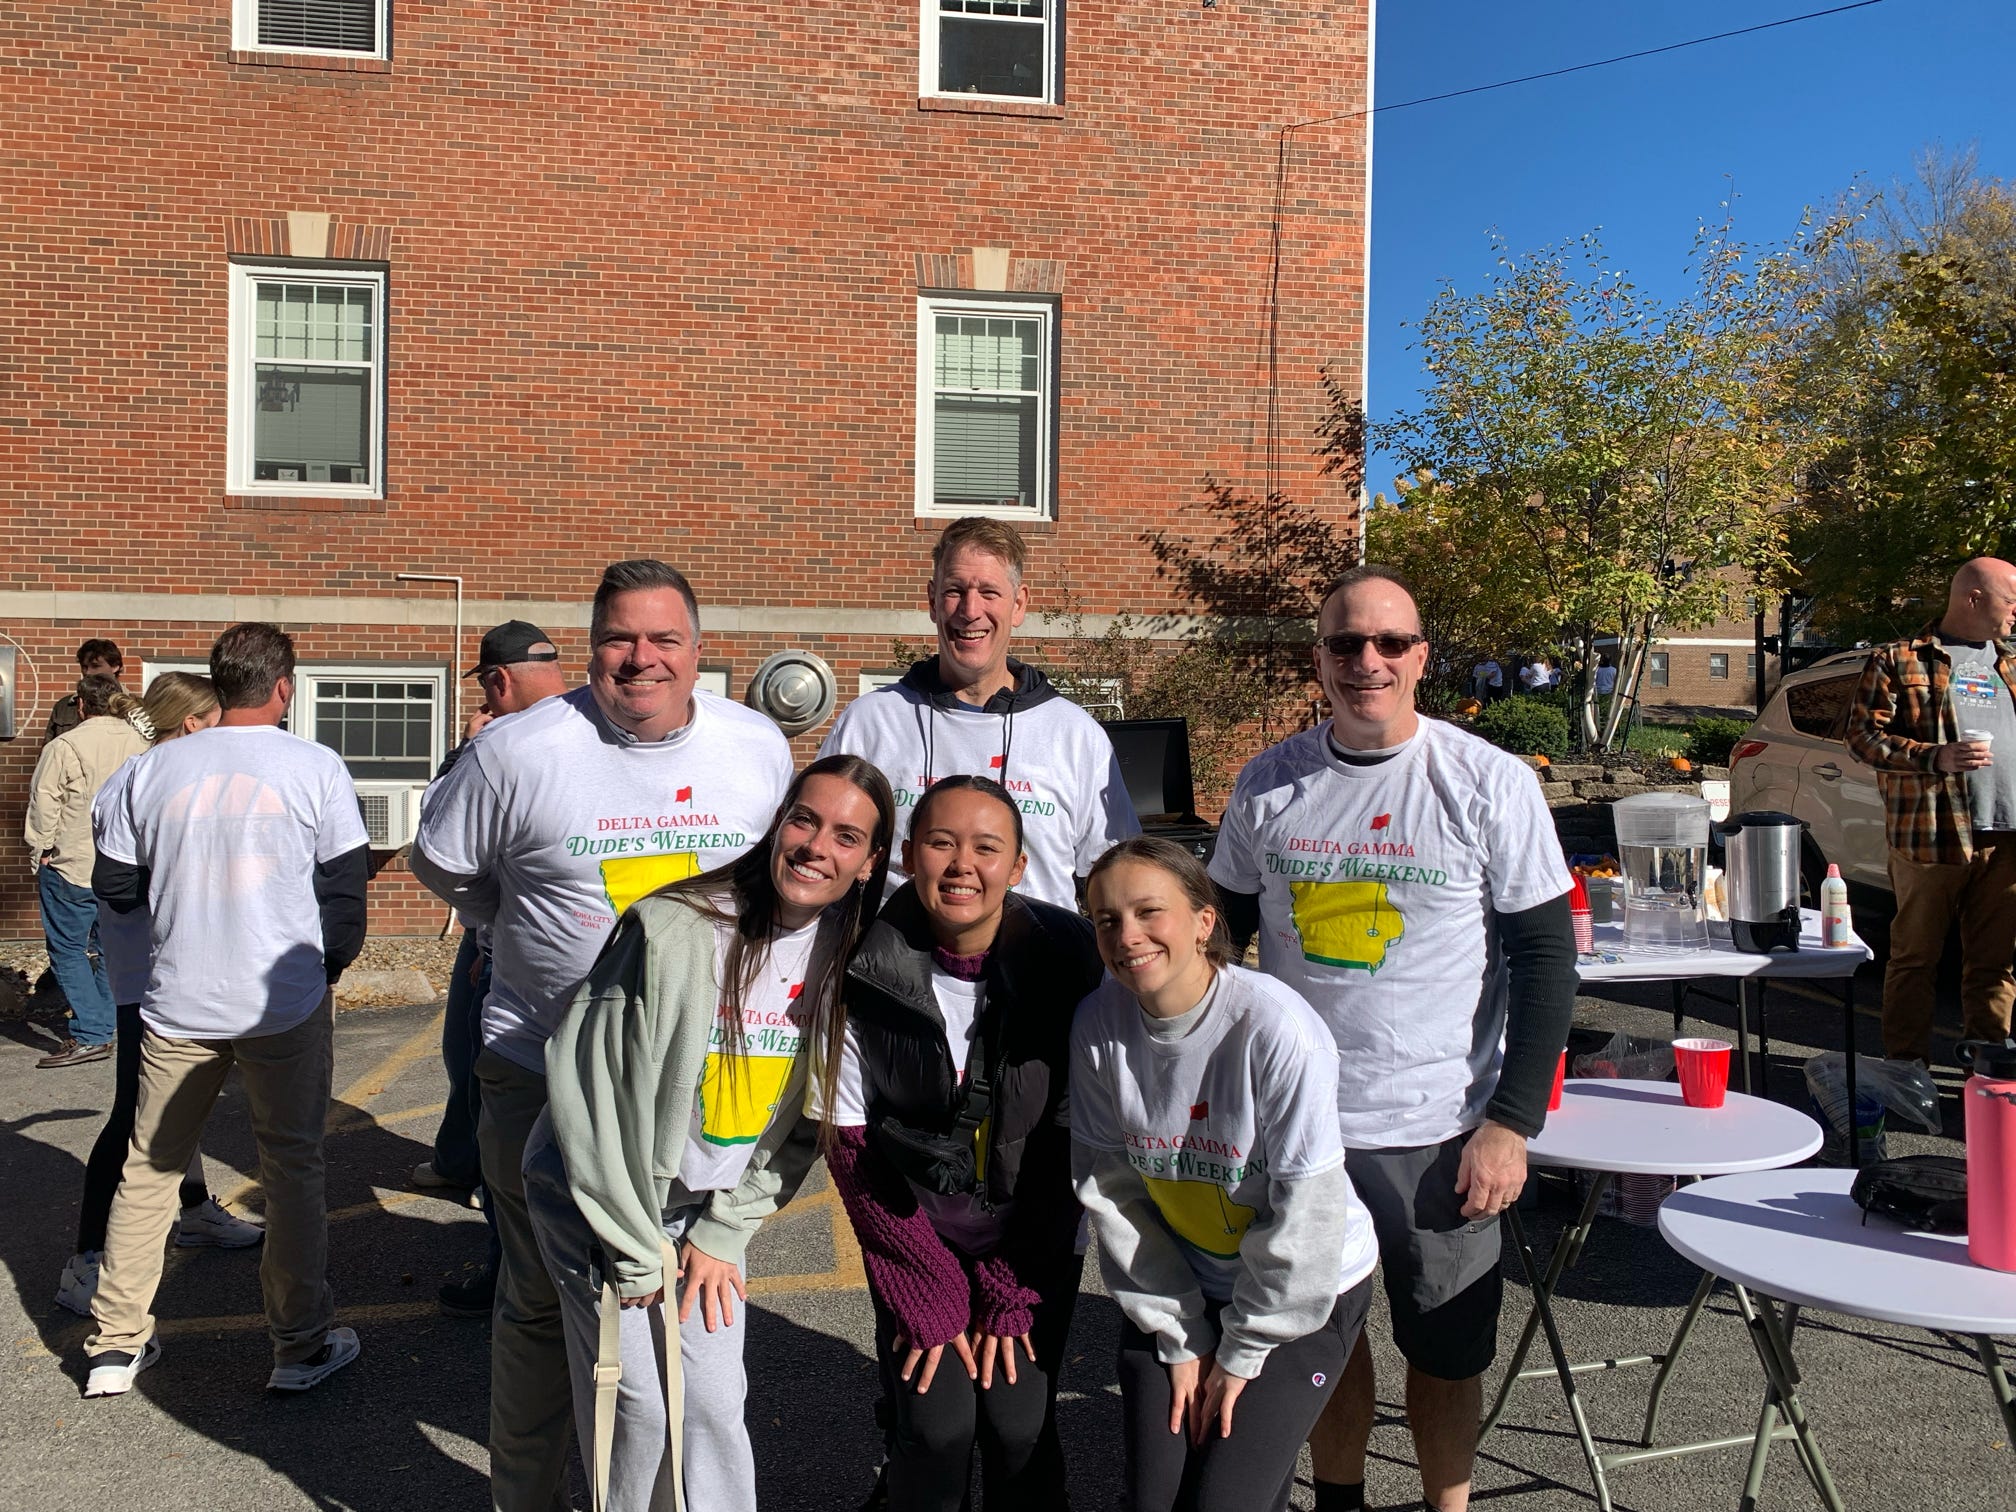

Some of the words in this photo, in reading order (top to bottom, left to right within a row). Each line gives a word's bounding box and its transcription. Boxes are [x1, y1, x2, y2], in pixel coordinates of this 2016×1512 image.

[1710, 798, 1730, 807] RESE
[597, 816, 652, 832] DELTA
[657, 813, 720, 827] GAMMA
[566, 836, 645, 857] DUDE'S
[650, 830, 746, 850] WEEKEND
[1288, 837, 1343, 855] DELTA
[1347, 842, 1416, 858] GAMMA
[1265, 853, 1334, 878] DUDE'S
[1338, 857, 1448, 887] WEEKEND
[573, 910, 592, 921] IOWA
[757, 1027, 810, 1053] WEEK
[1122, 1131, 1168, 1150] ELTA
[1170, 1134, 1243, 1159] GAMMA
[1168, 1152, 1264, 1184] WEEKEN
